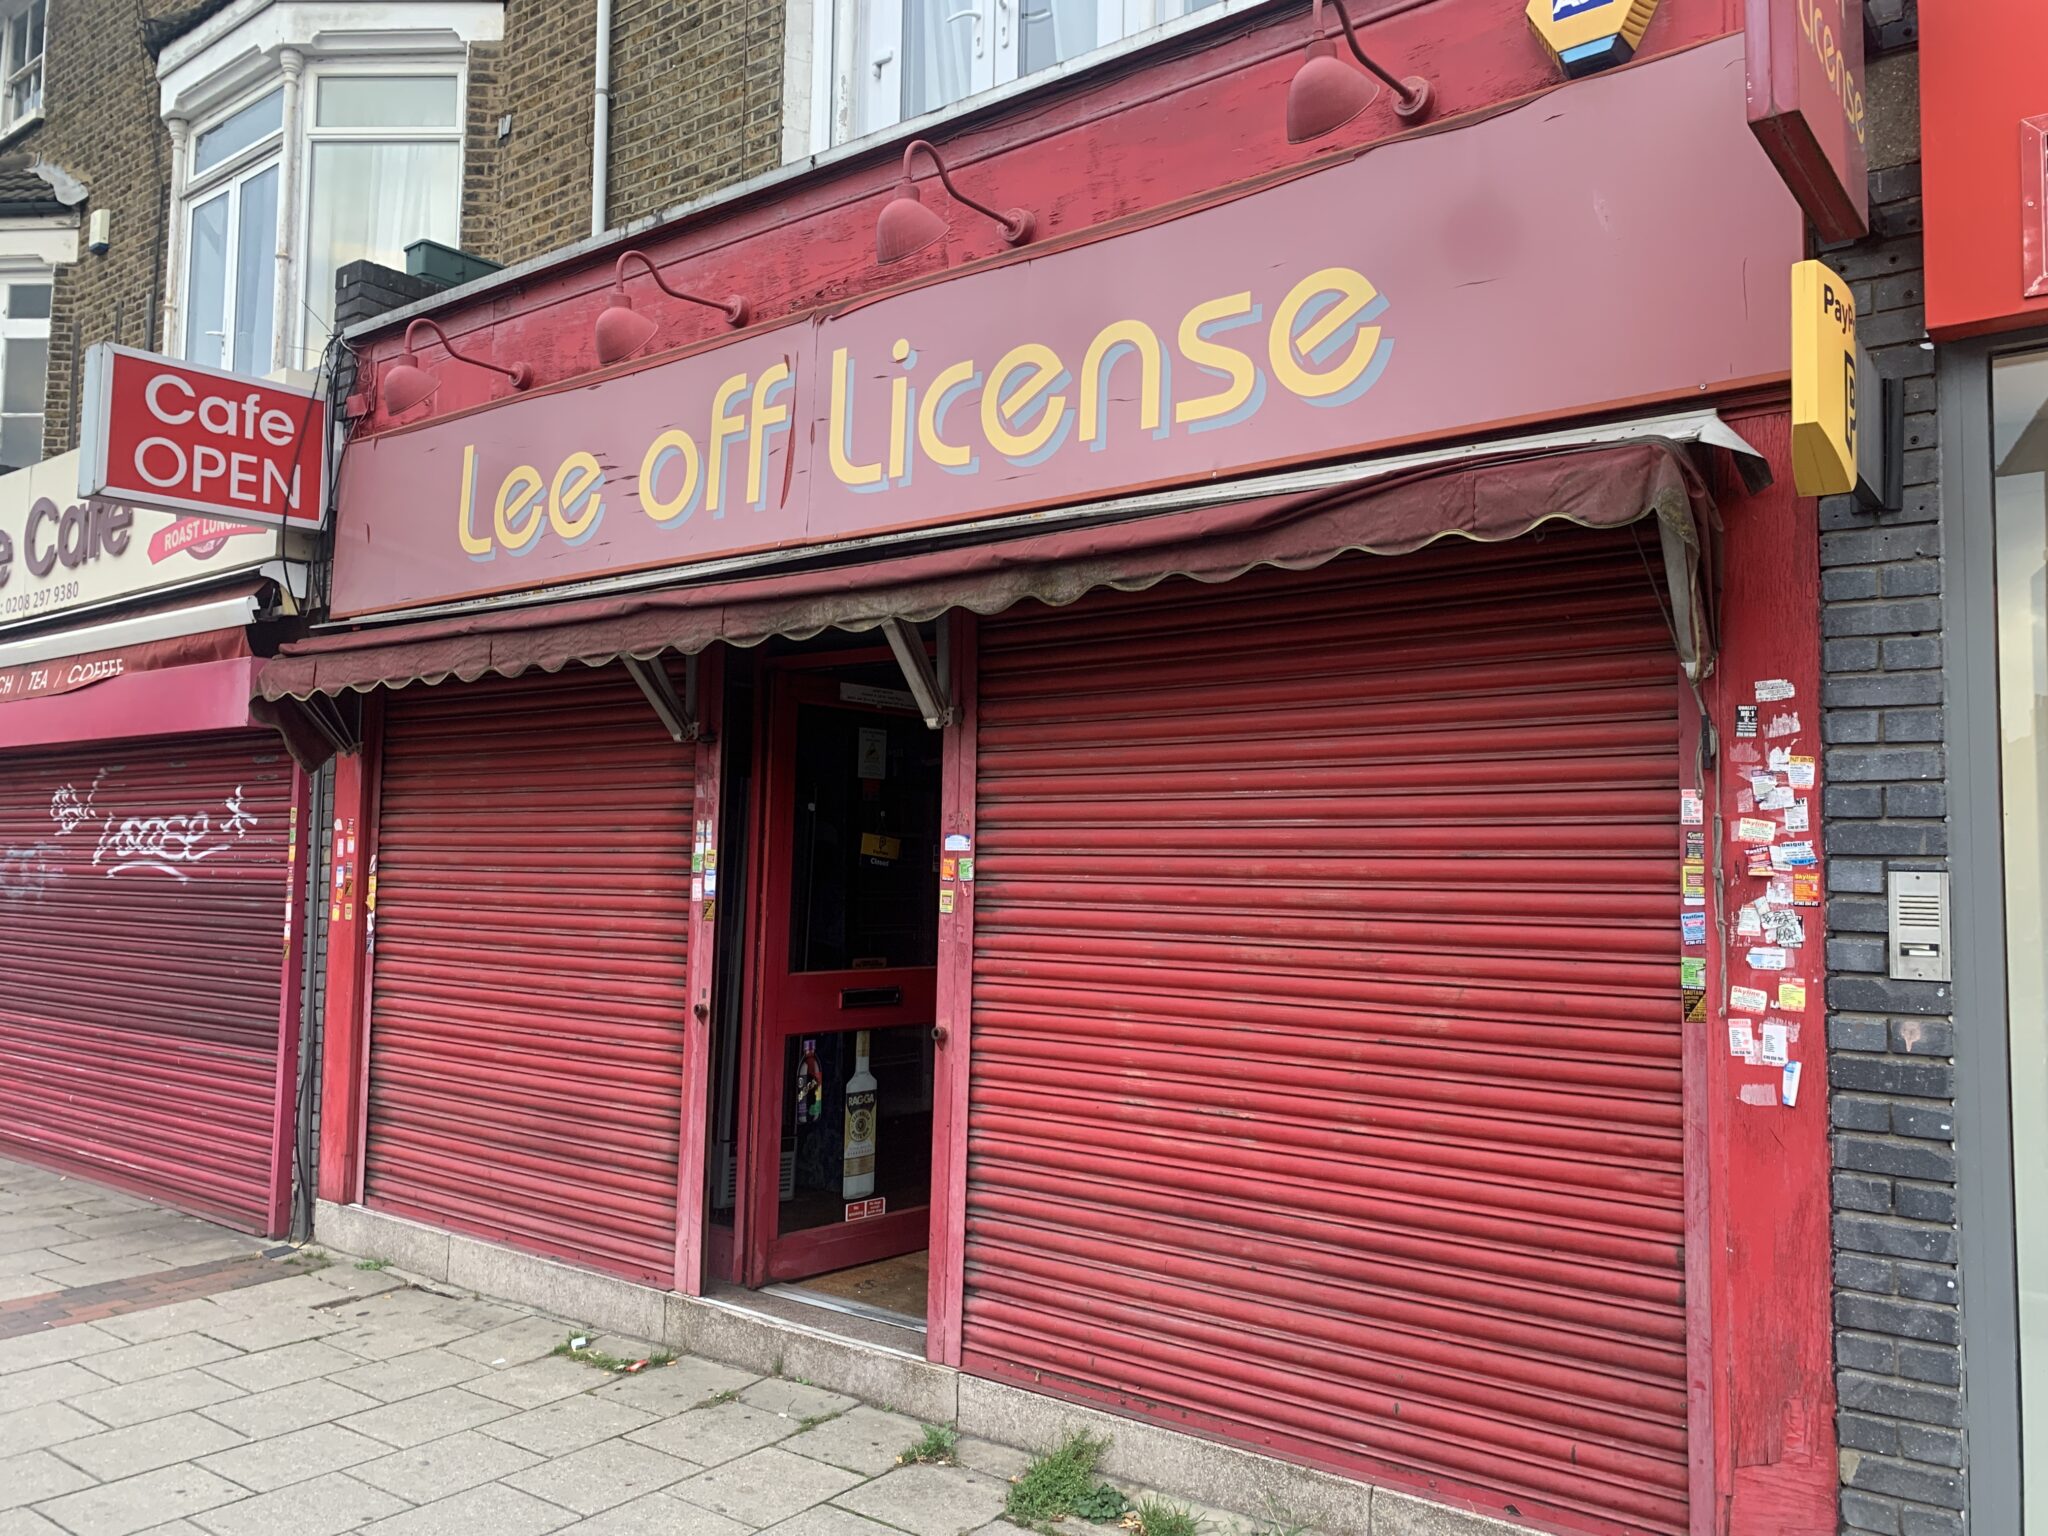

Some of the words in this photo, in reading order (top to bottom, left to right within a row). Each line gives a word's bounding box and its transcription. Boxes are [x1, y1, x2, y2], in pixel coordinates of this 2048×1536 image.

[145, 373, 295, 447] Cafe
[458, 444, 606, 561] Lee
[638, 362, 796, 529] off
[828, 267, 1394, 492] License
[134, 436, 301, 510] OPEN
[164, 519, 201, 552] ROAST
[5, 593, 31, 614] 0208
[33, 588, 51, 609] 297
[54, 580, 79, 603] 9380
[28, 669, 48, 691] TEA
